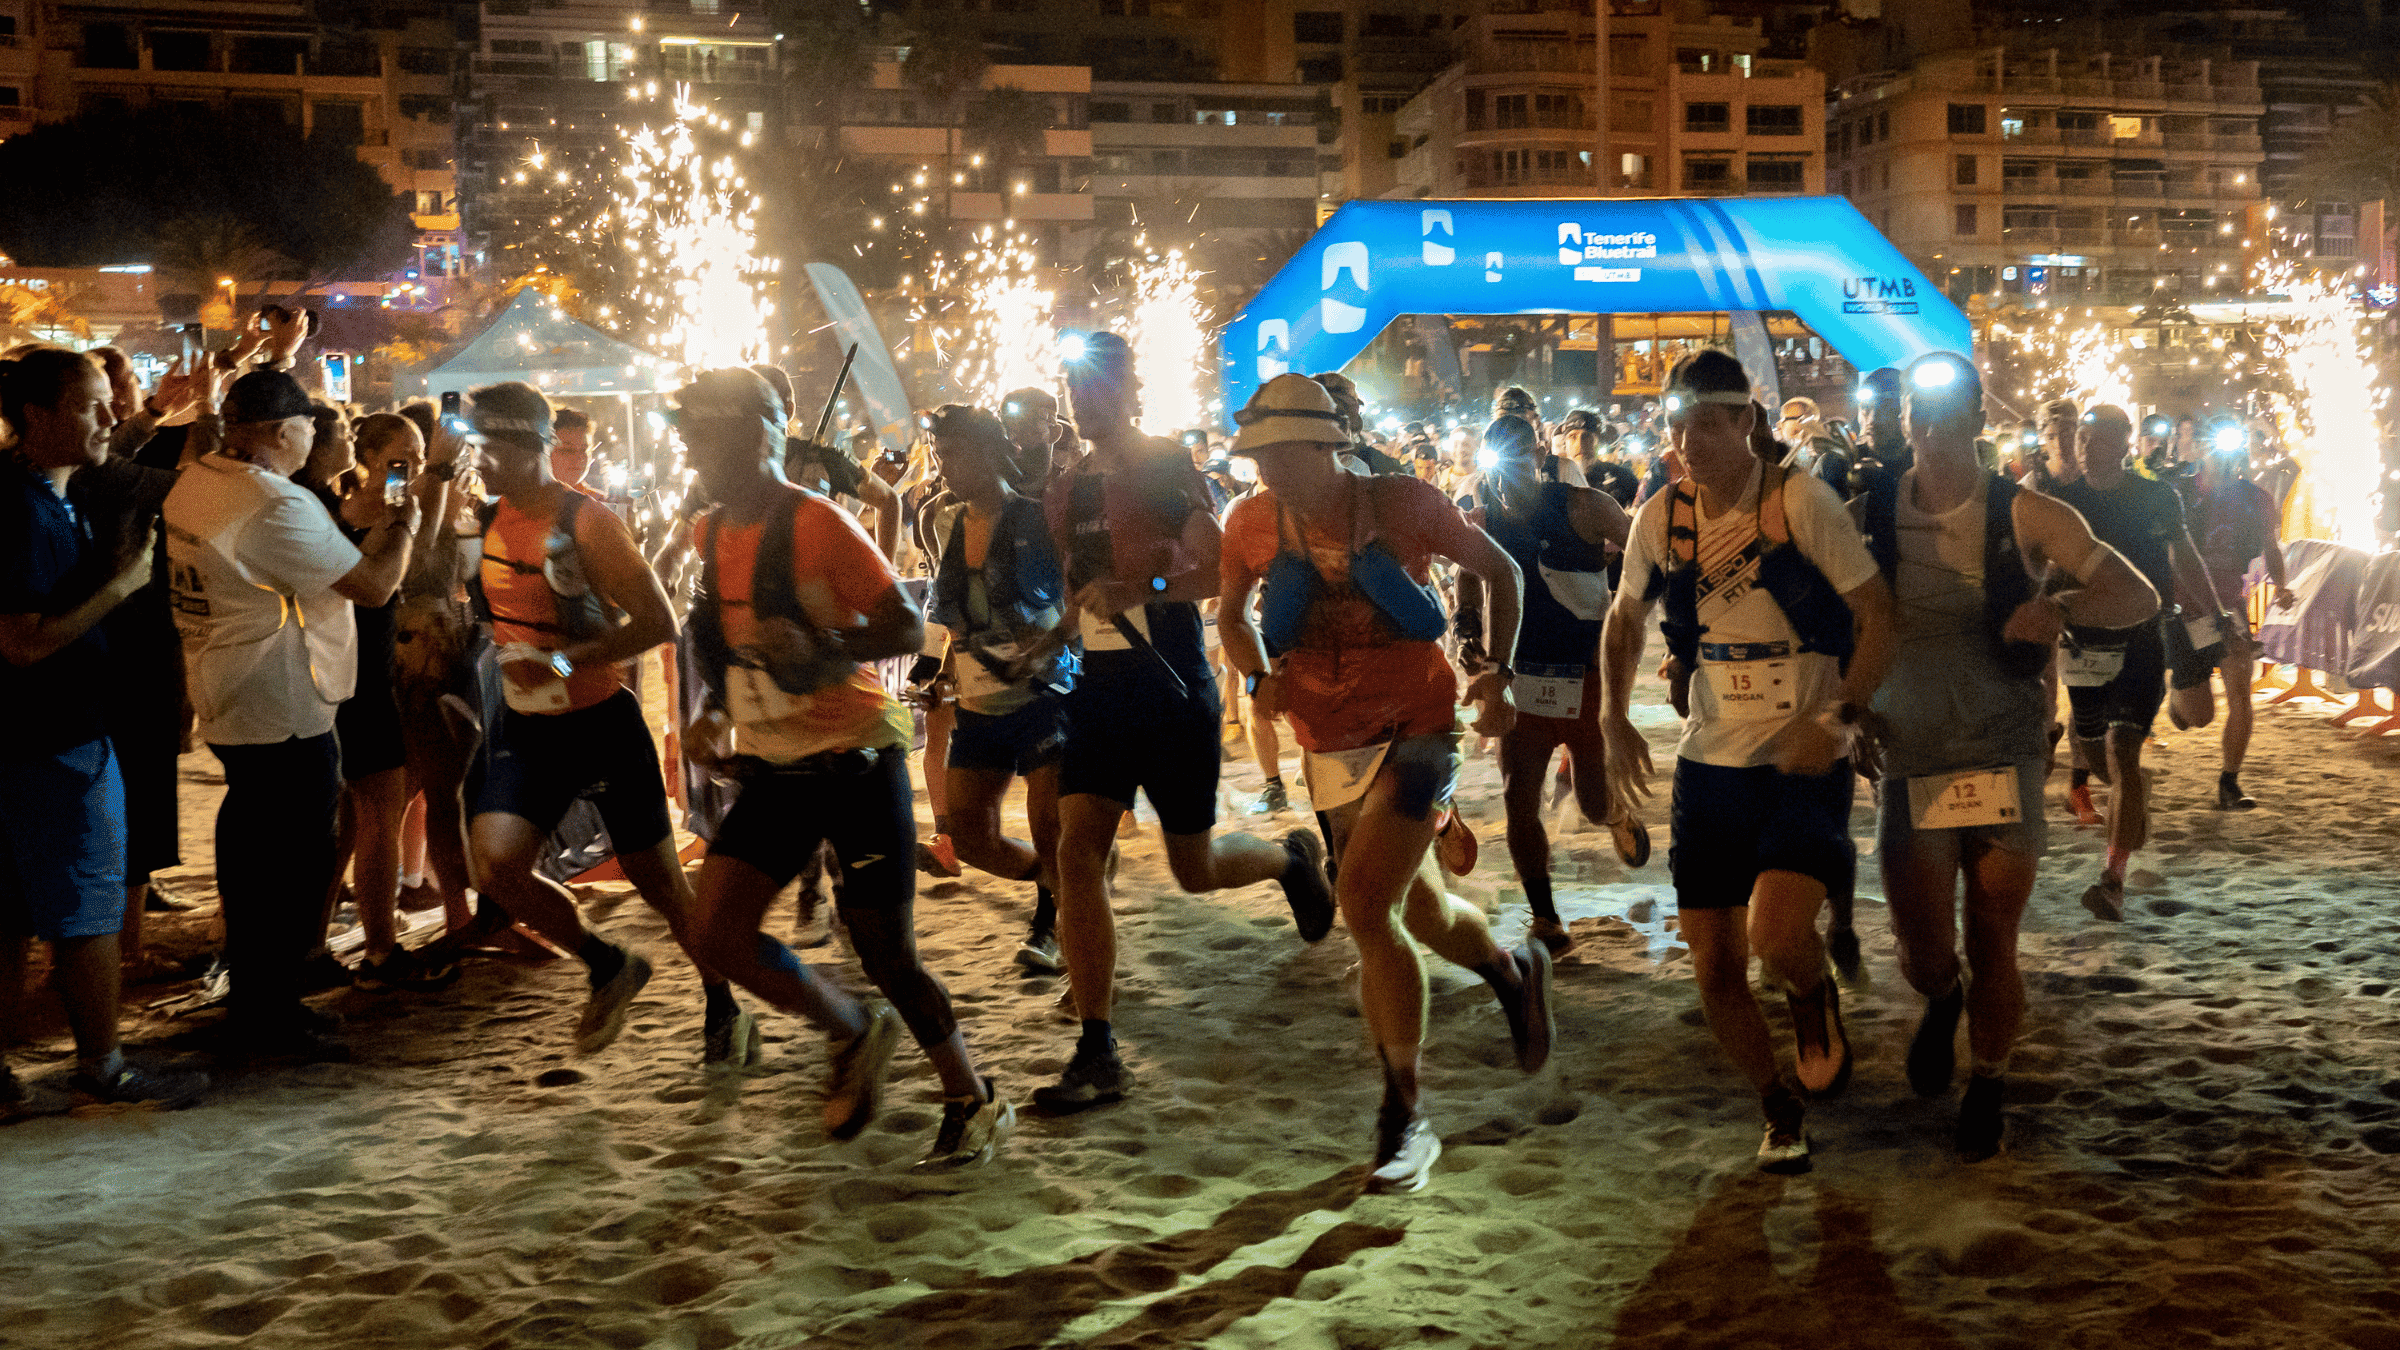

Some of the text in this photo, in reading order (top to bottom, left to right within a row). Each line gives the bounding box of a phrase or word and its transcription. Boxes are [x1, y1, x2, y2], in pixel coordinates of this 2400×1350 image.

[1583, 231, 1656, 245] Tenerife
[1584, 245, 1657, 259] Bluetrail
[1843, 277, 1916, 299] UTMB
[2082, 658, 2097, 669] 17
[1731, 674, 1752, 690] 15
[1541, 685, 1556, 697] 18
[1722, 693, 1765, 701] MORGAN
[1953, 783, 1977, 798] 12
